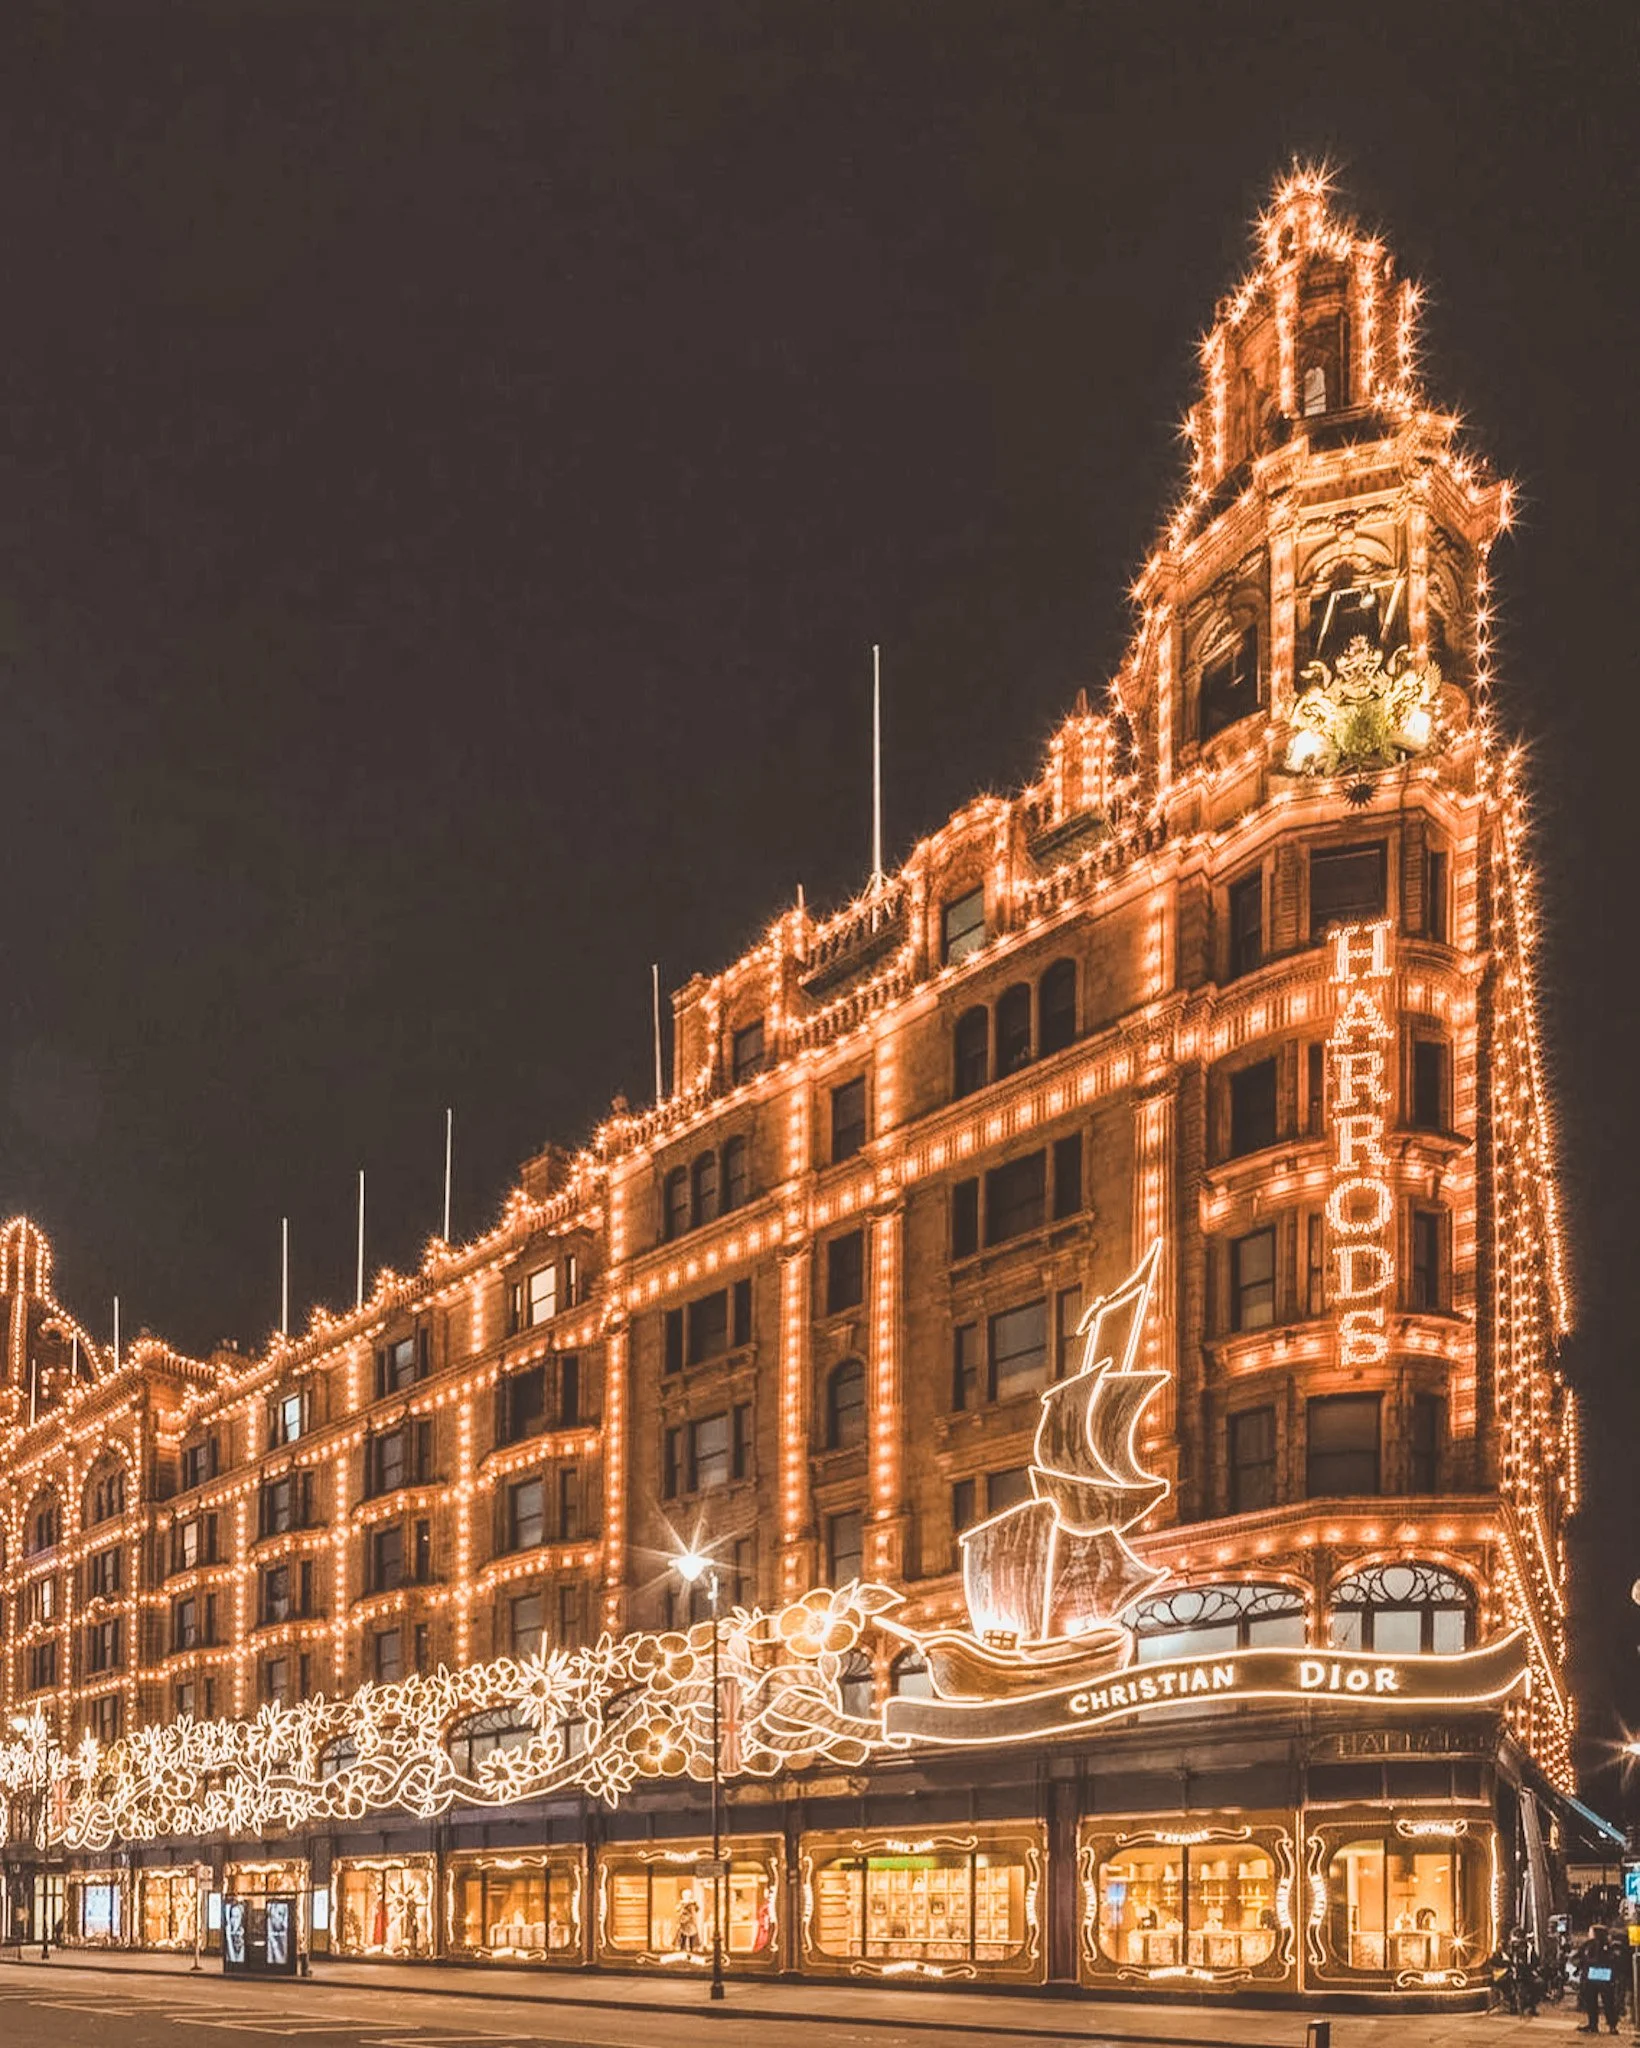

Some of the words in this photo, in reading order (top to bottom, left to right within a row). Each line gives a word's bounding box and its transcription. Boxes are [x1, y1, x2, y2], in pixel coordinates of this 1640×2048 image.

[1326, 919, 1394, 1368] HARRODS
[1068, 1664, 1236, 1715] CHRISTIAN
[1299, 1661, 1400, 1692] DIOR
